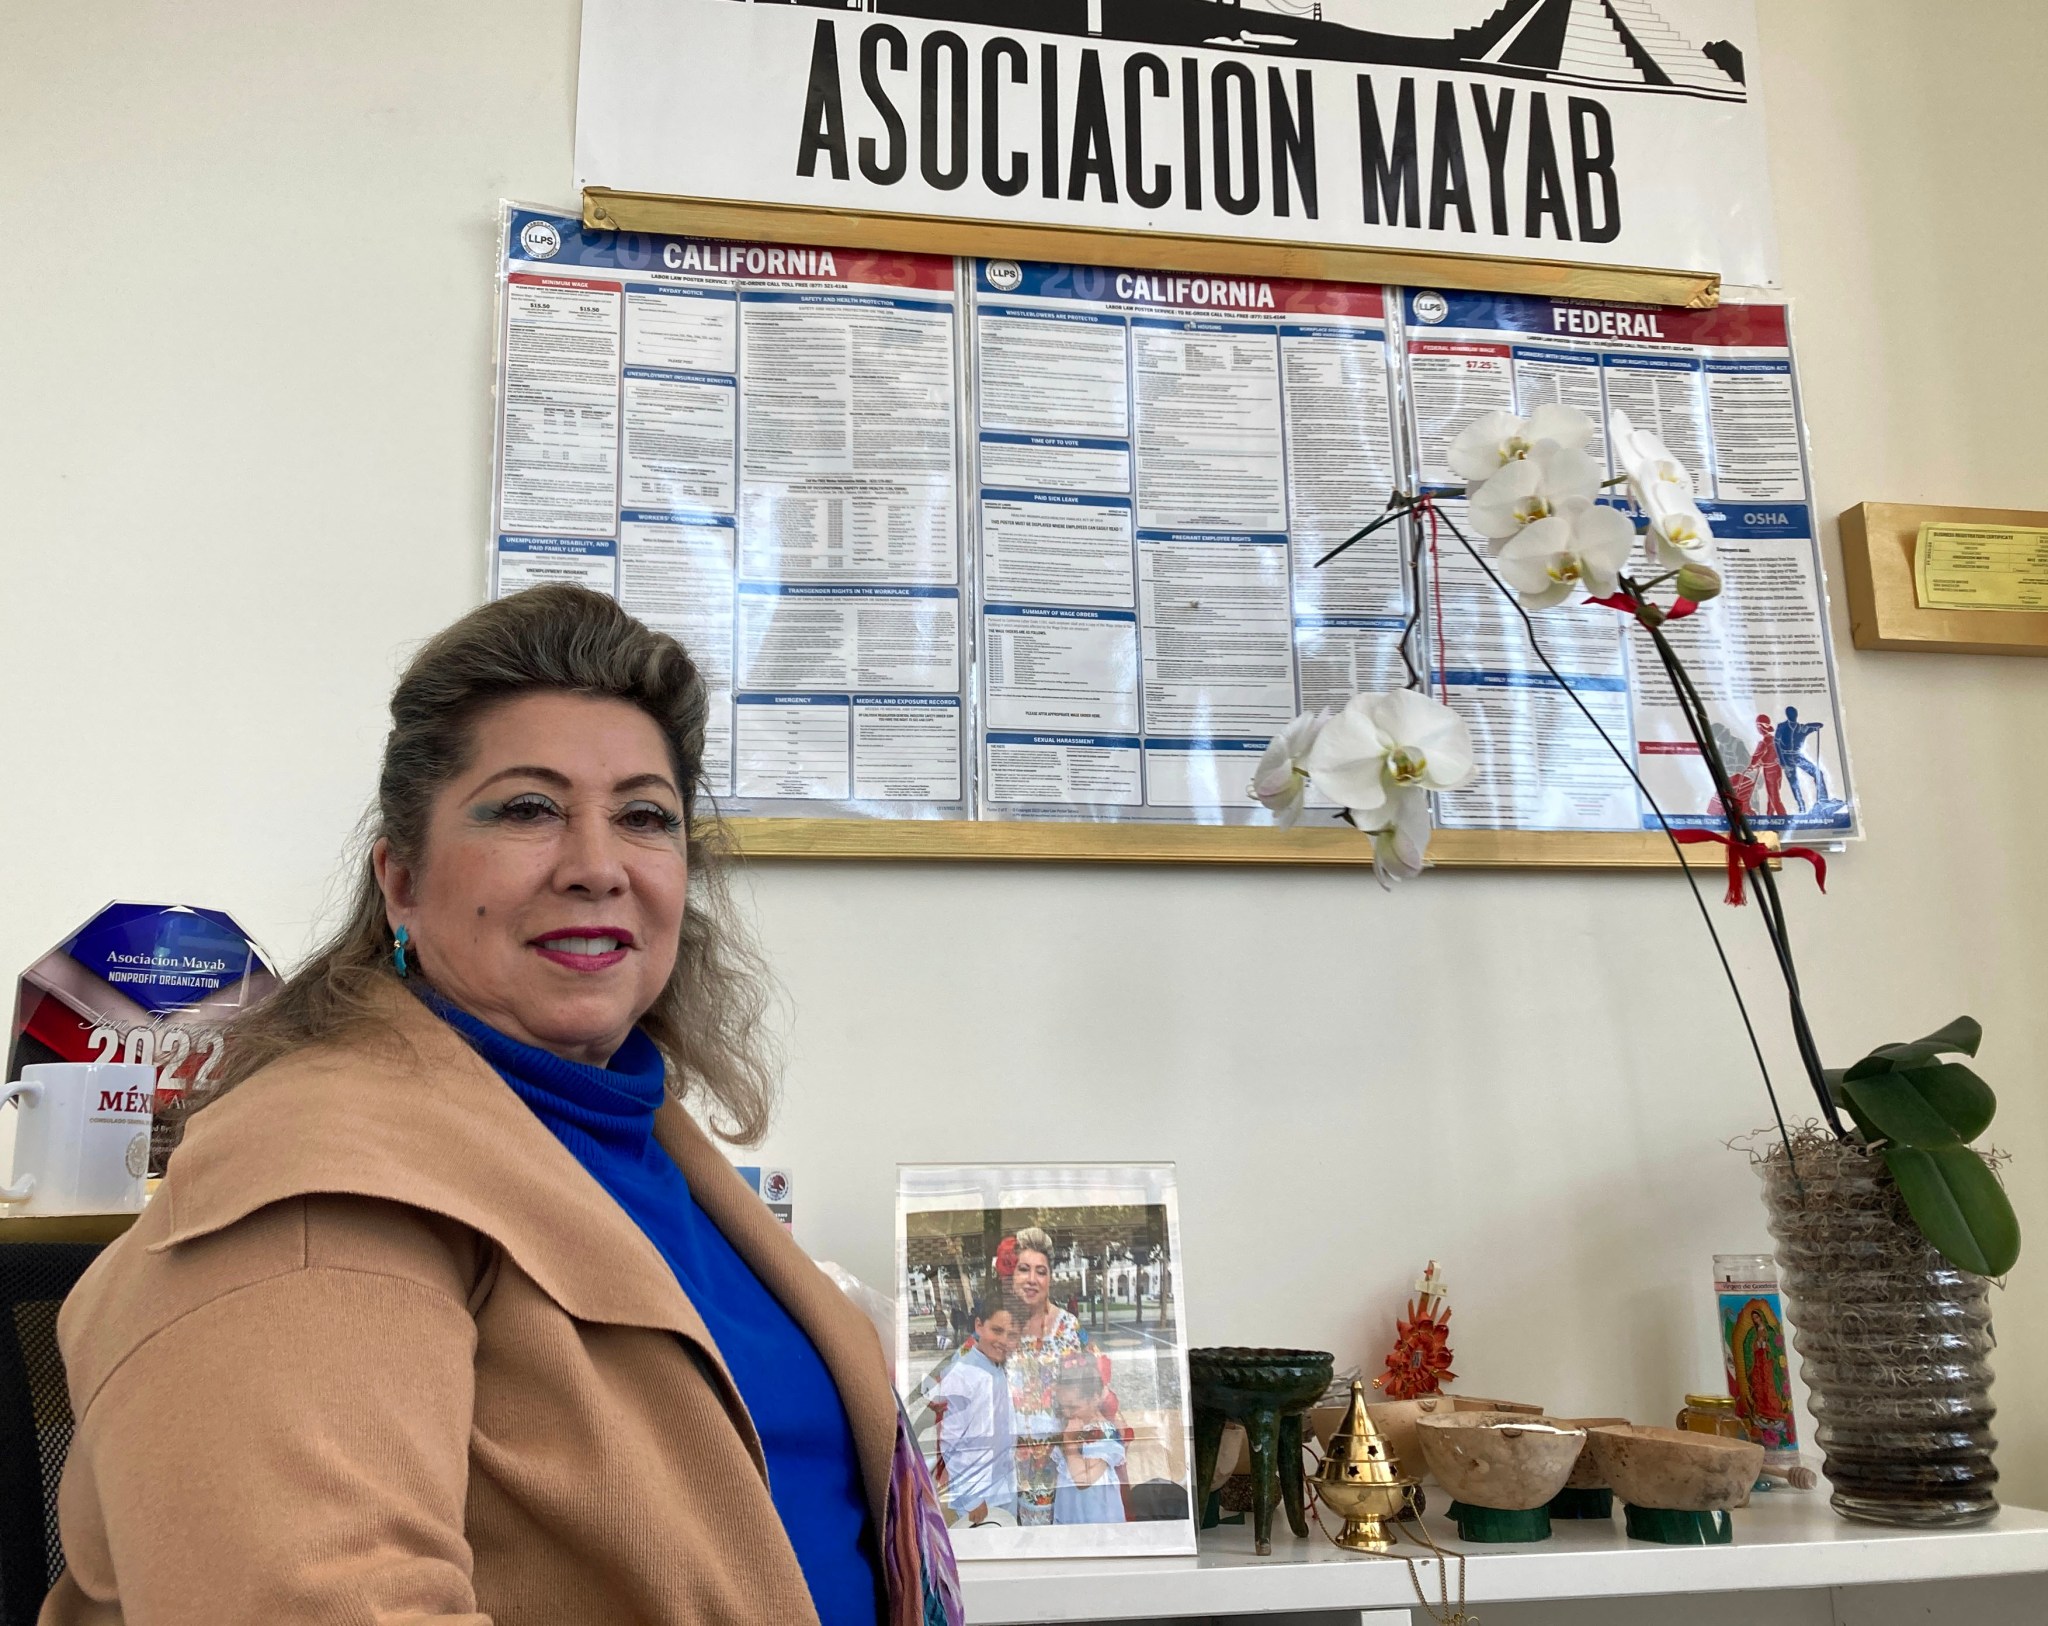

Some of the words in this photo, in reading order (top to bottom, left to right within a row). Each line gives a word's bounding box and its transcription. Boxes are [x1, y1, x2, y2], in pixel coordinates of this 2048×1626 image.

[796, 19, 1320, 220] ASOCIACION
[1357, 74, 1623, 243] MAYAB
[528, 234, 554, 246] LLPS
[663, 242, 838, 277] CALIFORNIA
[992, 268, 1017, 279] LLPS
[541, 279, 571, 287] MINIMUM
[659, 287, 682, 295] PAYDAY
[1115, 273, 1275, 309] CALIFORNIA
[859, 298, 894, 306] PROTECTION
[1420, 303, 1442, 311] LLPS
[1005, 309, 1055, 319] WHISTLEBLOWERS
[1067, 314, 1098, 322] PROTECTED
[1552, 307, 1665, 338] FEDERAL
[1466, 360, 1492, 369] $7.25
[627, 371, 673, 380] UNEMPLOYMENT
[674, 374, 706, 383] INSURANCE
[706, 377, 733, 385] BENEFITS
[1703, 511, 1727, 521] ealth
[1743, 512, 1789, 526] OSHA
[506, 537, 558, 546] UNEMPLOYMENT,
[560, 539, 595, 547] DISABILITY,
[544, 545, 566, 553] FAMILY
[1022, 608, 1049, 616] SUMMARY
[897, 698, 928, 706] EXPOSURE
[1033, 736, 1056, 744] SEXUAL
[106, 950, 178, 967] Asociacion
[182, 956, 226, 971] Mayab
[108, 971, 158, 985] NONPROFIT
[158, 974, 220, 989] ORGANIZATION
[87, 1024, 224, 1091] 2022
